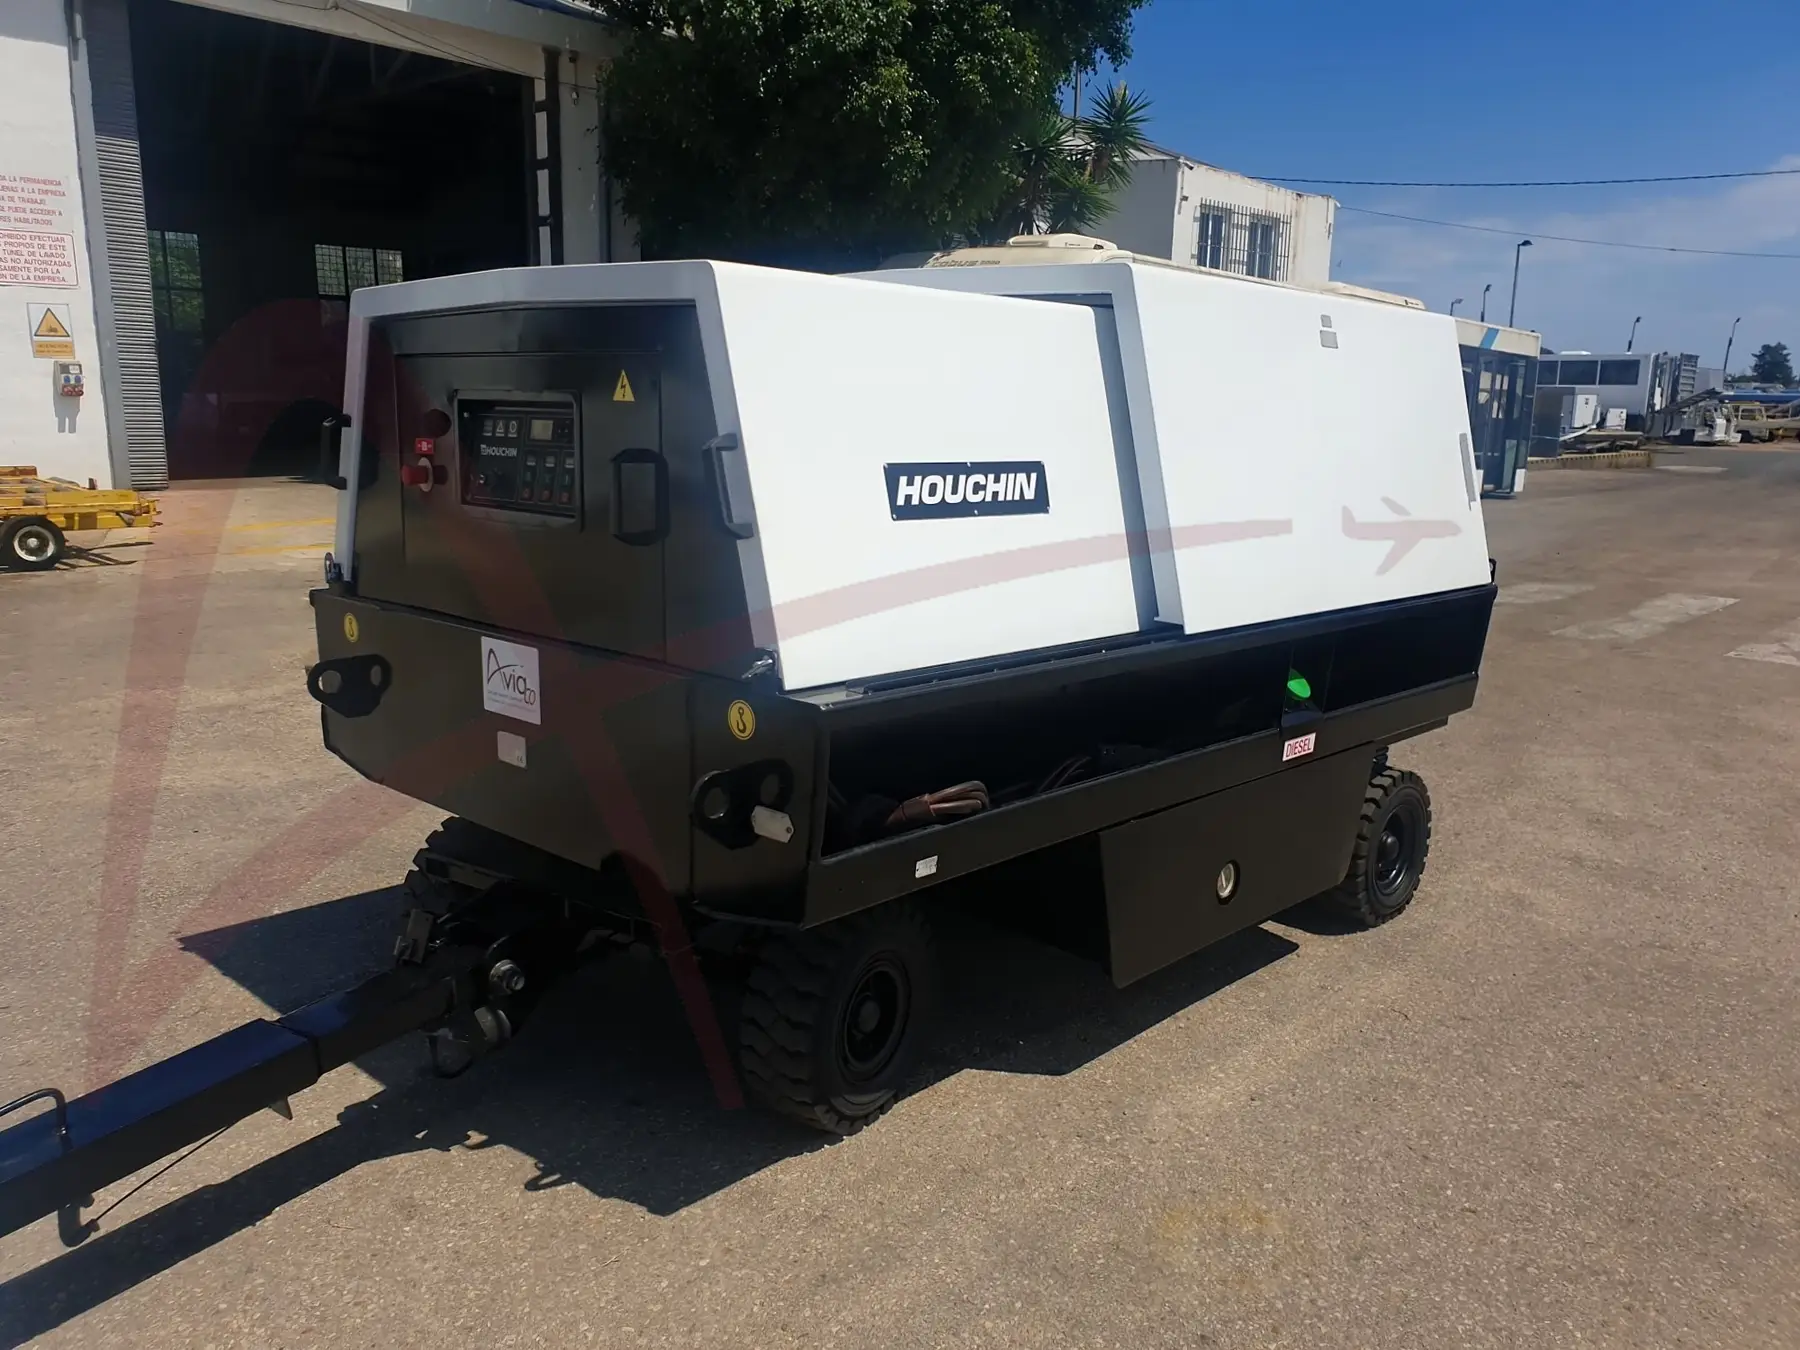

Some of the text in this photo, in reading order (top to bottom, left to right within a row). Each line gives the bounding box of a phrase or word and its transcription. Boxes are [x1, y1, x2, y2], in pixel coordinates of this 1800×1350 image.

[38, 188, 66, 197] EMPRESA
[29, 235, 65, 243] EFECTUAR
[4, 241, 35, 249] PROPIOS
[24, 259, 72, 267] AUTORIZADAS
[487, 446, 518, 457] HOUCHIN
[896, 473, 1038, 506] HOUCHIN
[1286, 738, 1311, 757] DIESEL
